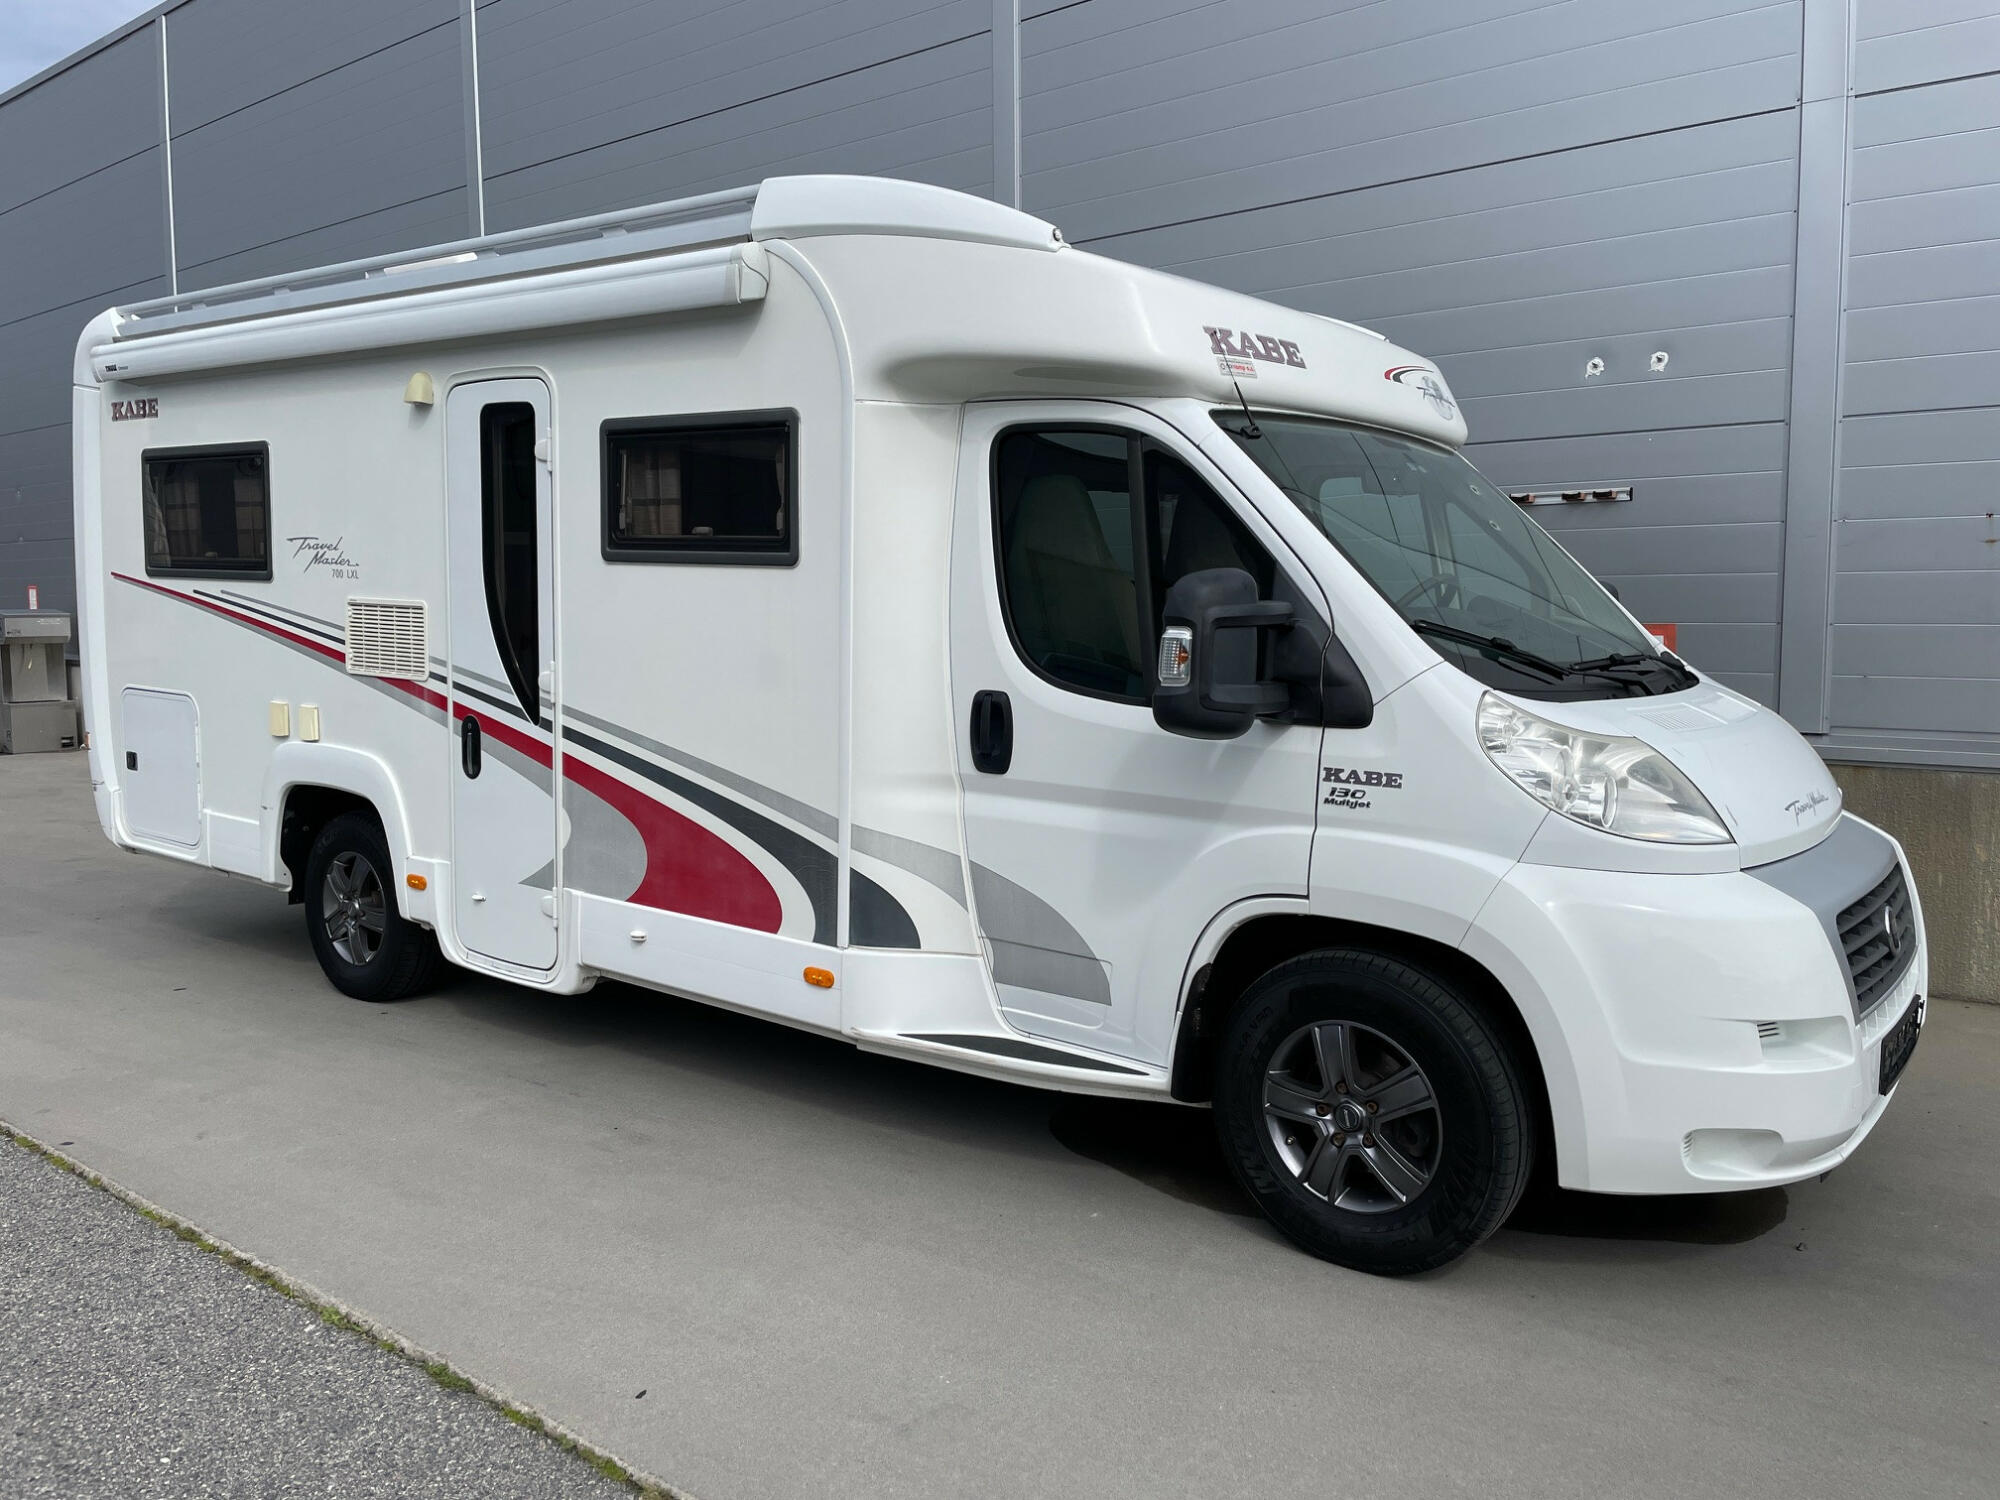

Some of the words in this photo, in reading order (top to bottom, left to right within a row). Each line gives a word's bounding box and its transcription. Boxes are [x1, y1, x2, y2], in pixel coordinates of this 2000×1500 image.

[1202, 326, 1307, 369] KABE
[111, 398, 159, 421] KABE
[286, 536, 343, 560] Travel
[304, 551, 360, 573] Master
[332, 568, 344, 579] 700
[346, 569, 360, 580] LXL
[1322, 767, 1403, 789] KABE
[1329, 787, 1366, 799] 130
